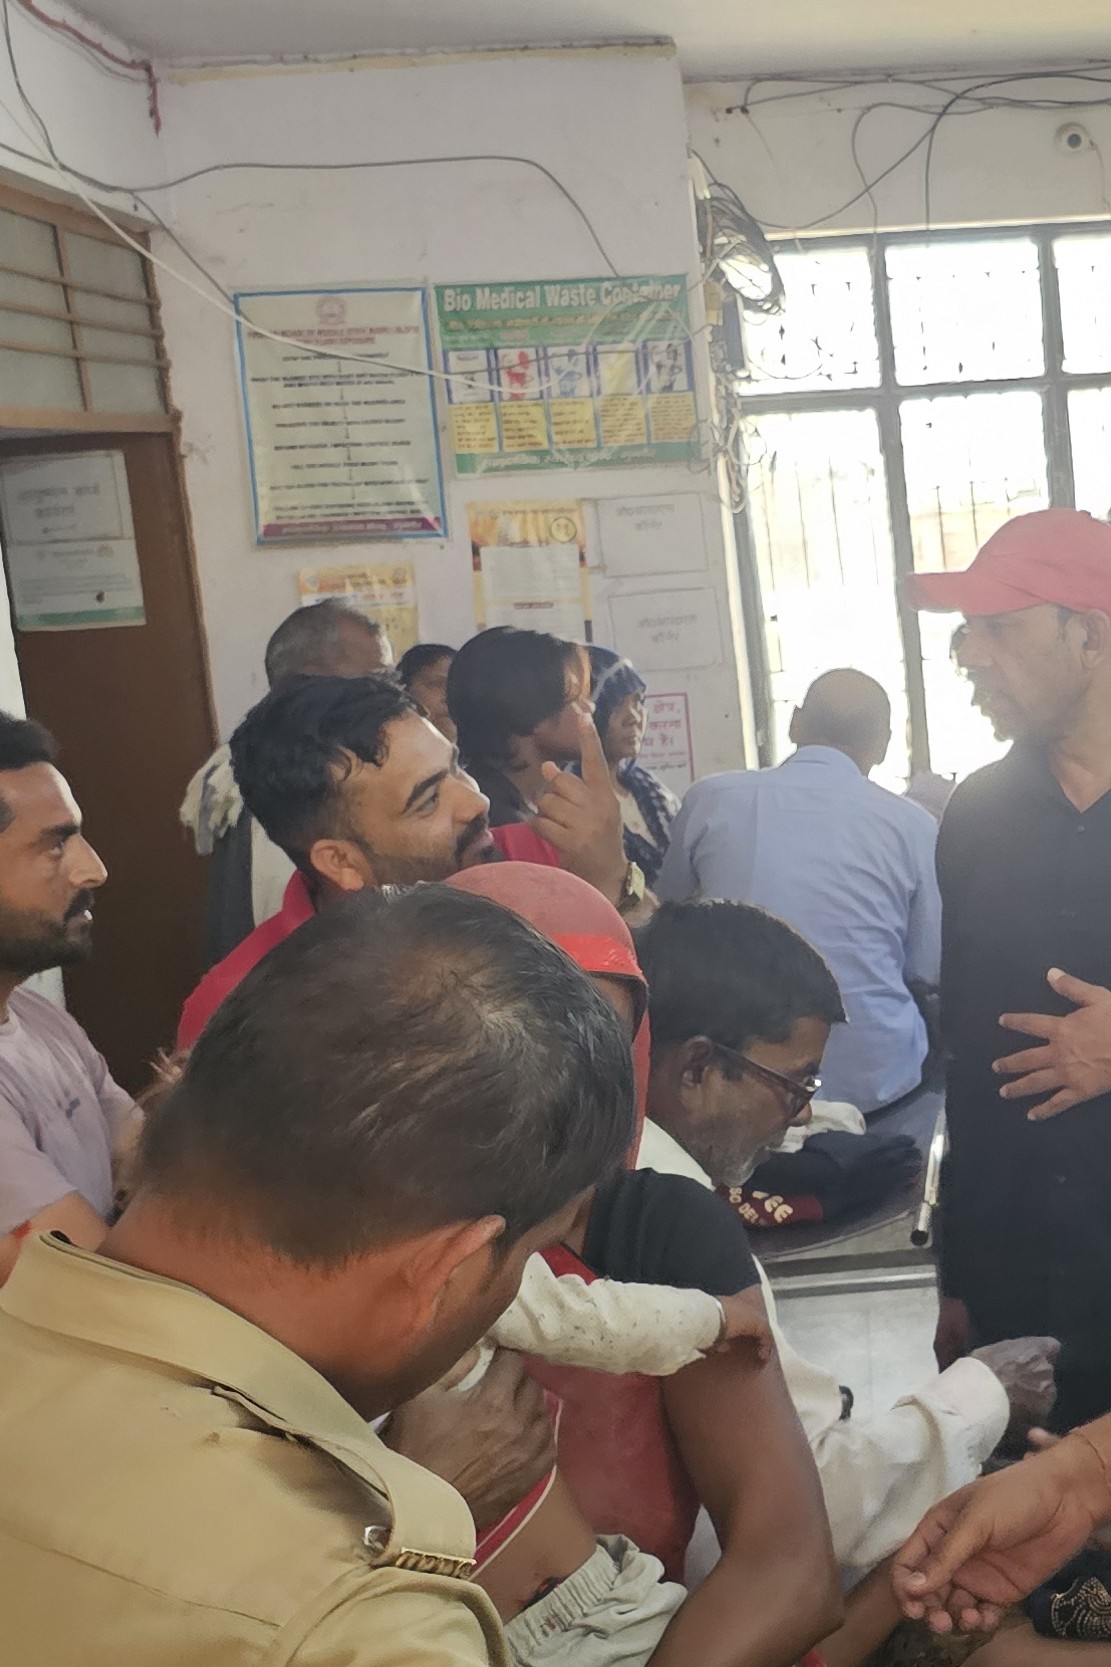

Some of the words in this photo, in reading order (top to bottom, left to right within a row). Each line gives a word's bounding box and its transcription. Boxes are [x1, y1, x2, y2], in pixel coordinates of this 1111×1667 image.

[444, 288, 471, 312] Bio
[475, 285, 541, 310] Medical
[544, 283, 596, 307] Waste
